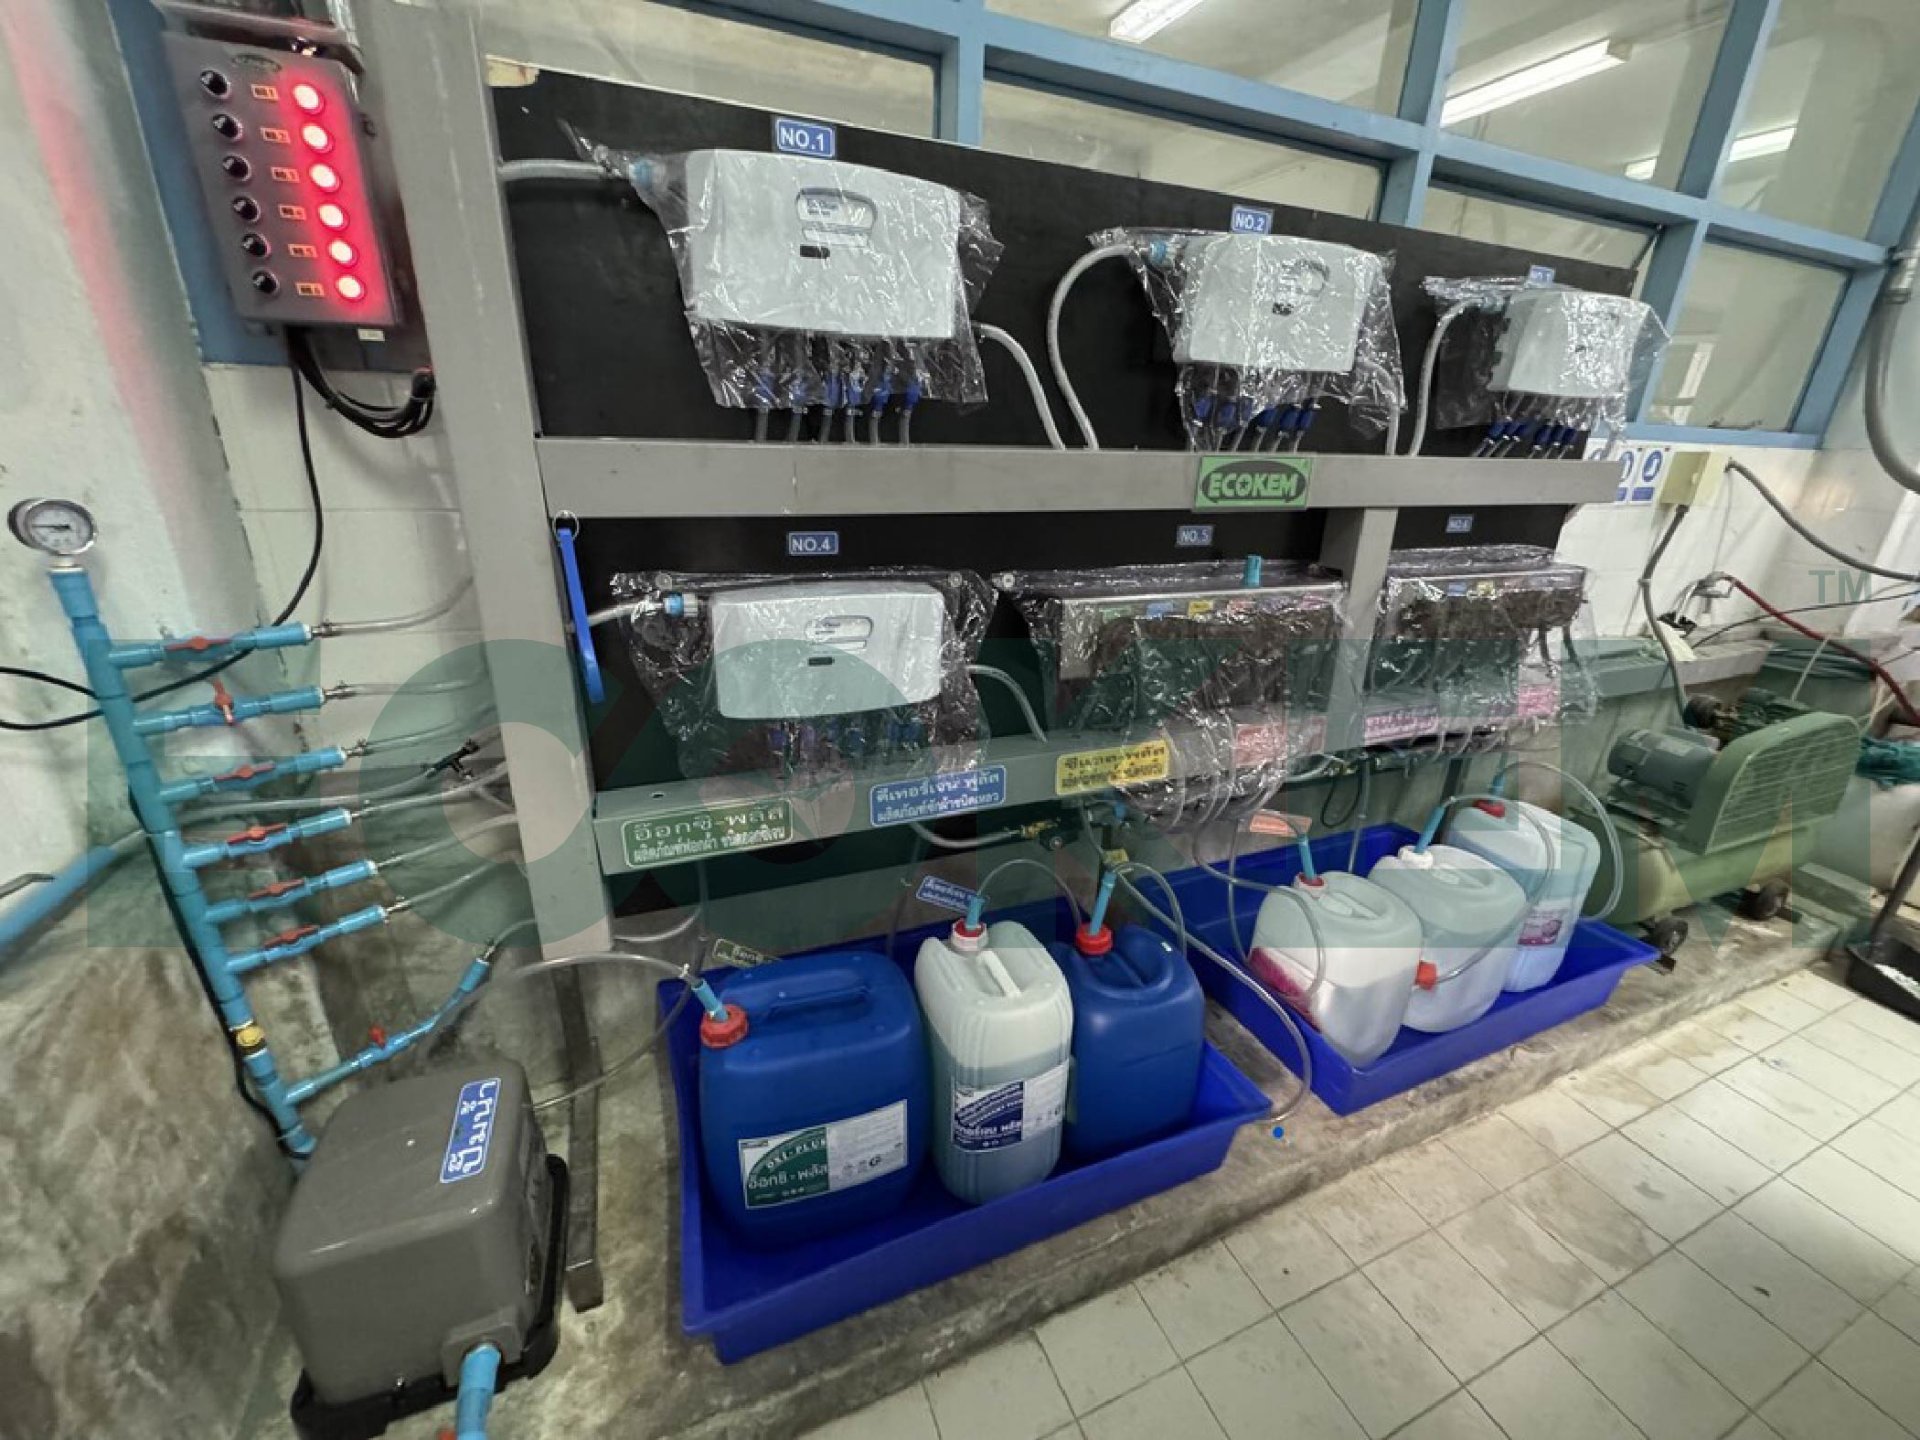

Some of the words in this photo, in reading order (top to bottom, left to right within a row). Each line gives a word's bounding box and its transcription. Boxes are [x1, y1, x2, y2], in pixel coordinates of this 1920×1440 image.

[780, 127, 825, 151] NO.1
[1235, 212, 1265, 231] NO.2
[1208, 473, 1299, 497] ECOKEM
[792, 537, 831, 551] NO.4
[1182, 529, 1209, 543] NO.5
